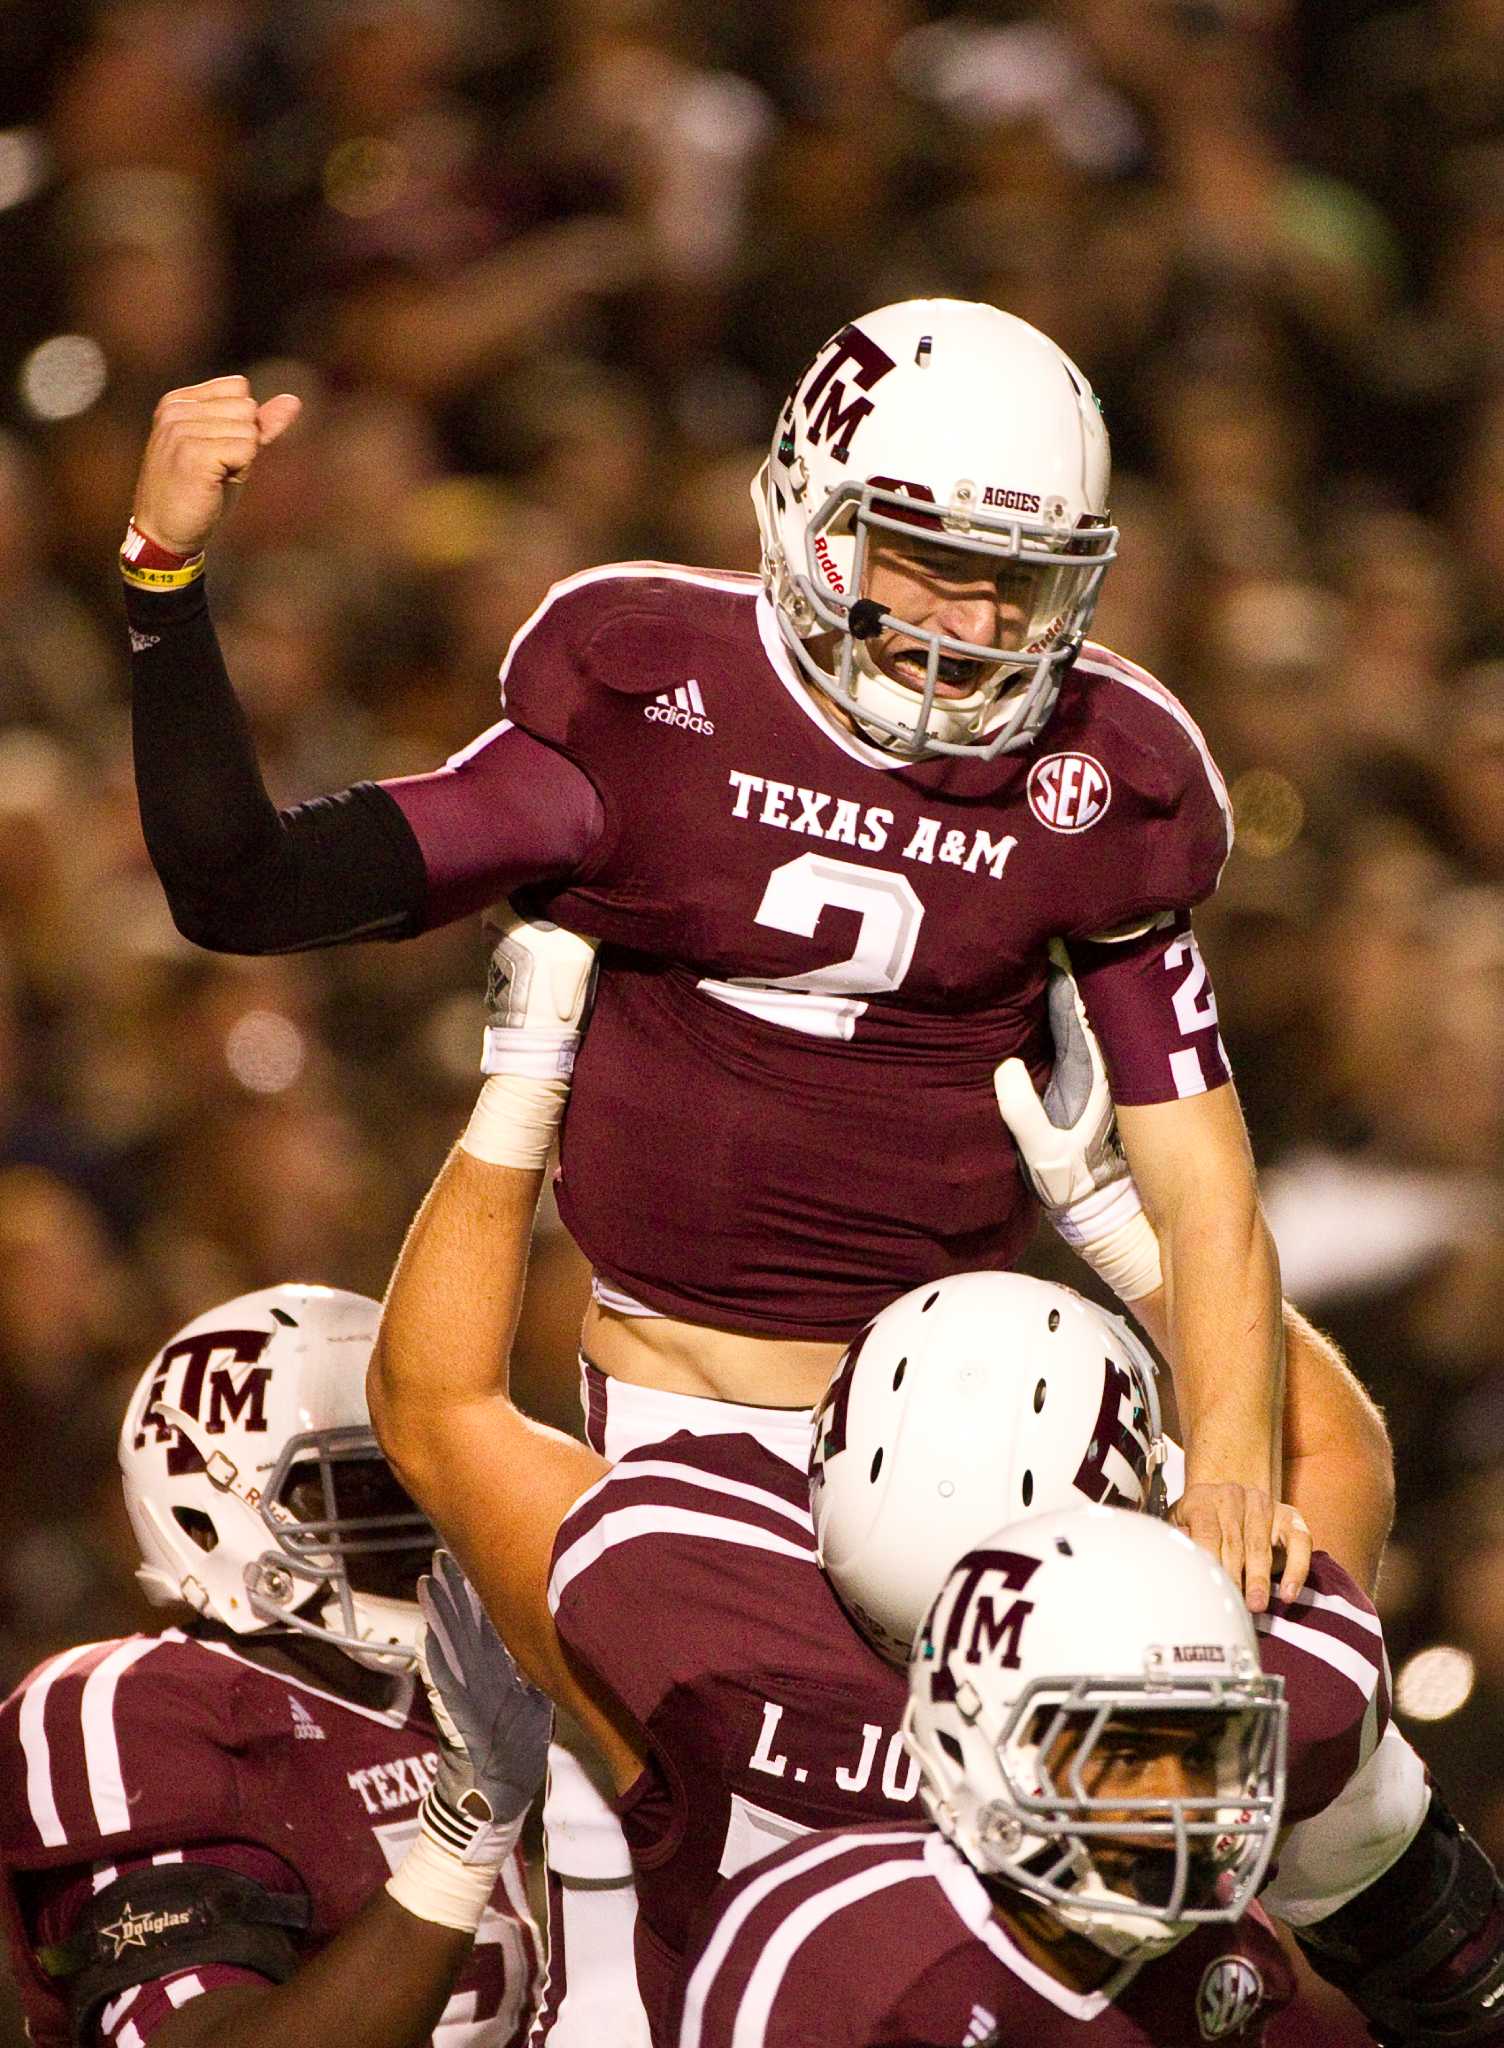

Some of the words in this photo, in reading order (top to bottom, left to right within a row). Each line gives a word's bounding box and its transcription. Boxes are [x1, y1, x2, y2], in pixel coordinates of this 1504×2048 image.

[982, 486, 1041, 514] AGGIES
[815, 537, 847, 614] Ridde
[643, 705, 716, 736] adidas
[729, 769, 895, 853] TEXAS
[902, 815, 1019, 880] A&M
[1034, 759, 1104, 827] SEC
[696, 851, 926, 1042] 2
[1163, 929, 1219, 1036] 2
[1172, 1645, 1226, 1663] AGGIES
[748, 1701, 809, 1783] L.
[122, 1911, 190, 1939] Douglas
